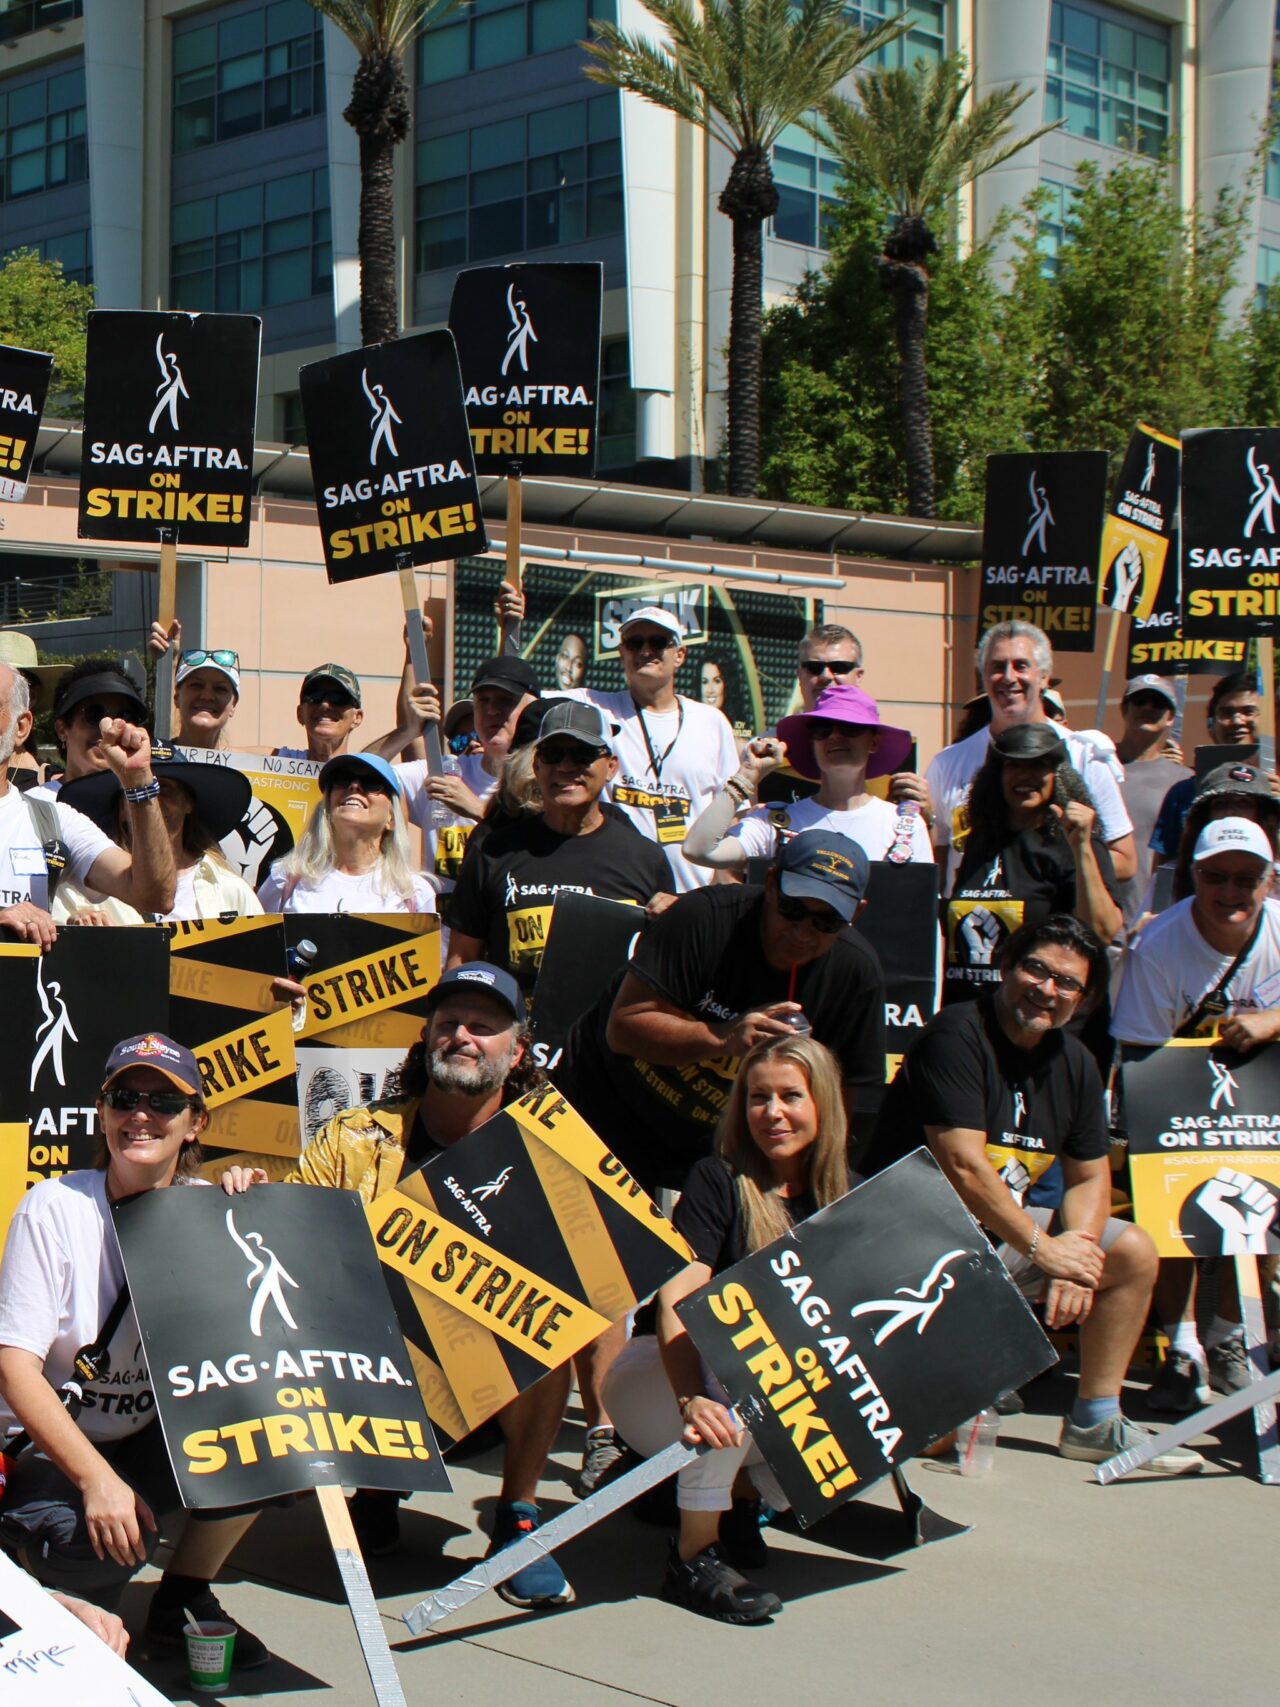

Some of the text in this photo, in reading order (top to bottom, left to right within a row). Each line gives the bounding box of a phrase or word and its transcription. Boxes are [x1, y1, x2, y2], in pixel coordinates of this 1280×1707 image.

[502, 410, 531, 425] ON
[469, 428, 591, 456] TRIKE!
[149, 472, 181, 488] ON
[86, 487, 244, 524] STRIKE!
[381, 497, 411, 517] ON
[329, 503, 477, 559] STRIKE!
[1022, 590, 1048, 603] ON
[1187, 589, 1280, 617] STRI
[1130, 639, 1246, 664] STRIKE!
[205, 752, 232, 767] PAY
[263, 758, 283, 773] NO
[514, 914, 545, 943] ON
[306, 947, 428, 1020] STRIKE
[197, 1029, 280, 1098] RIKE
[1158, 1131, 1197, 1148] ON
[29, 1144, 69, 1166] ON
[376, 1207, 573, 1352] ON STRIKE
[794, 1346, 832, 1393] ON
[80, 1389, 156, 1415] STRO
[276, 1386, 327, 1408] ON
[707, 1282, 861, 1499] STRIKE!
[182, 1411, 431, 1474] STRIKE!
